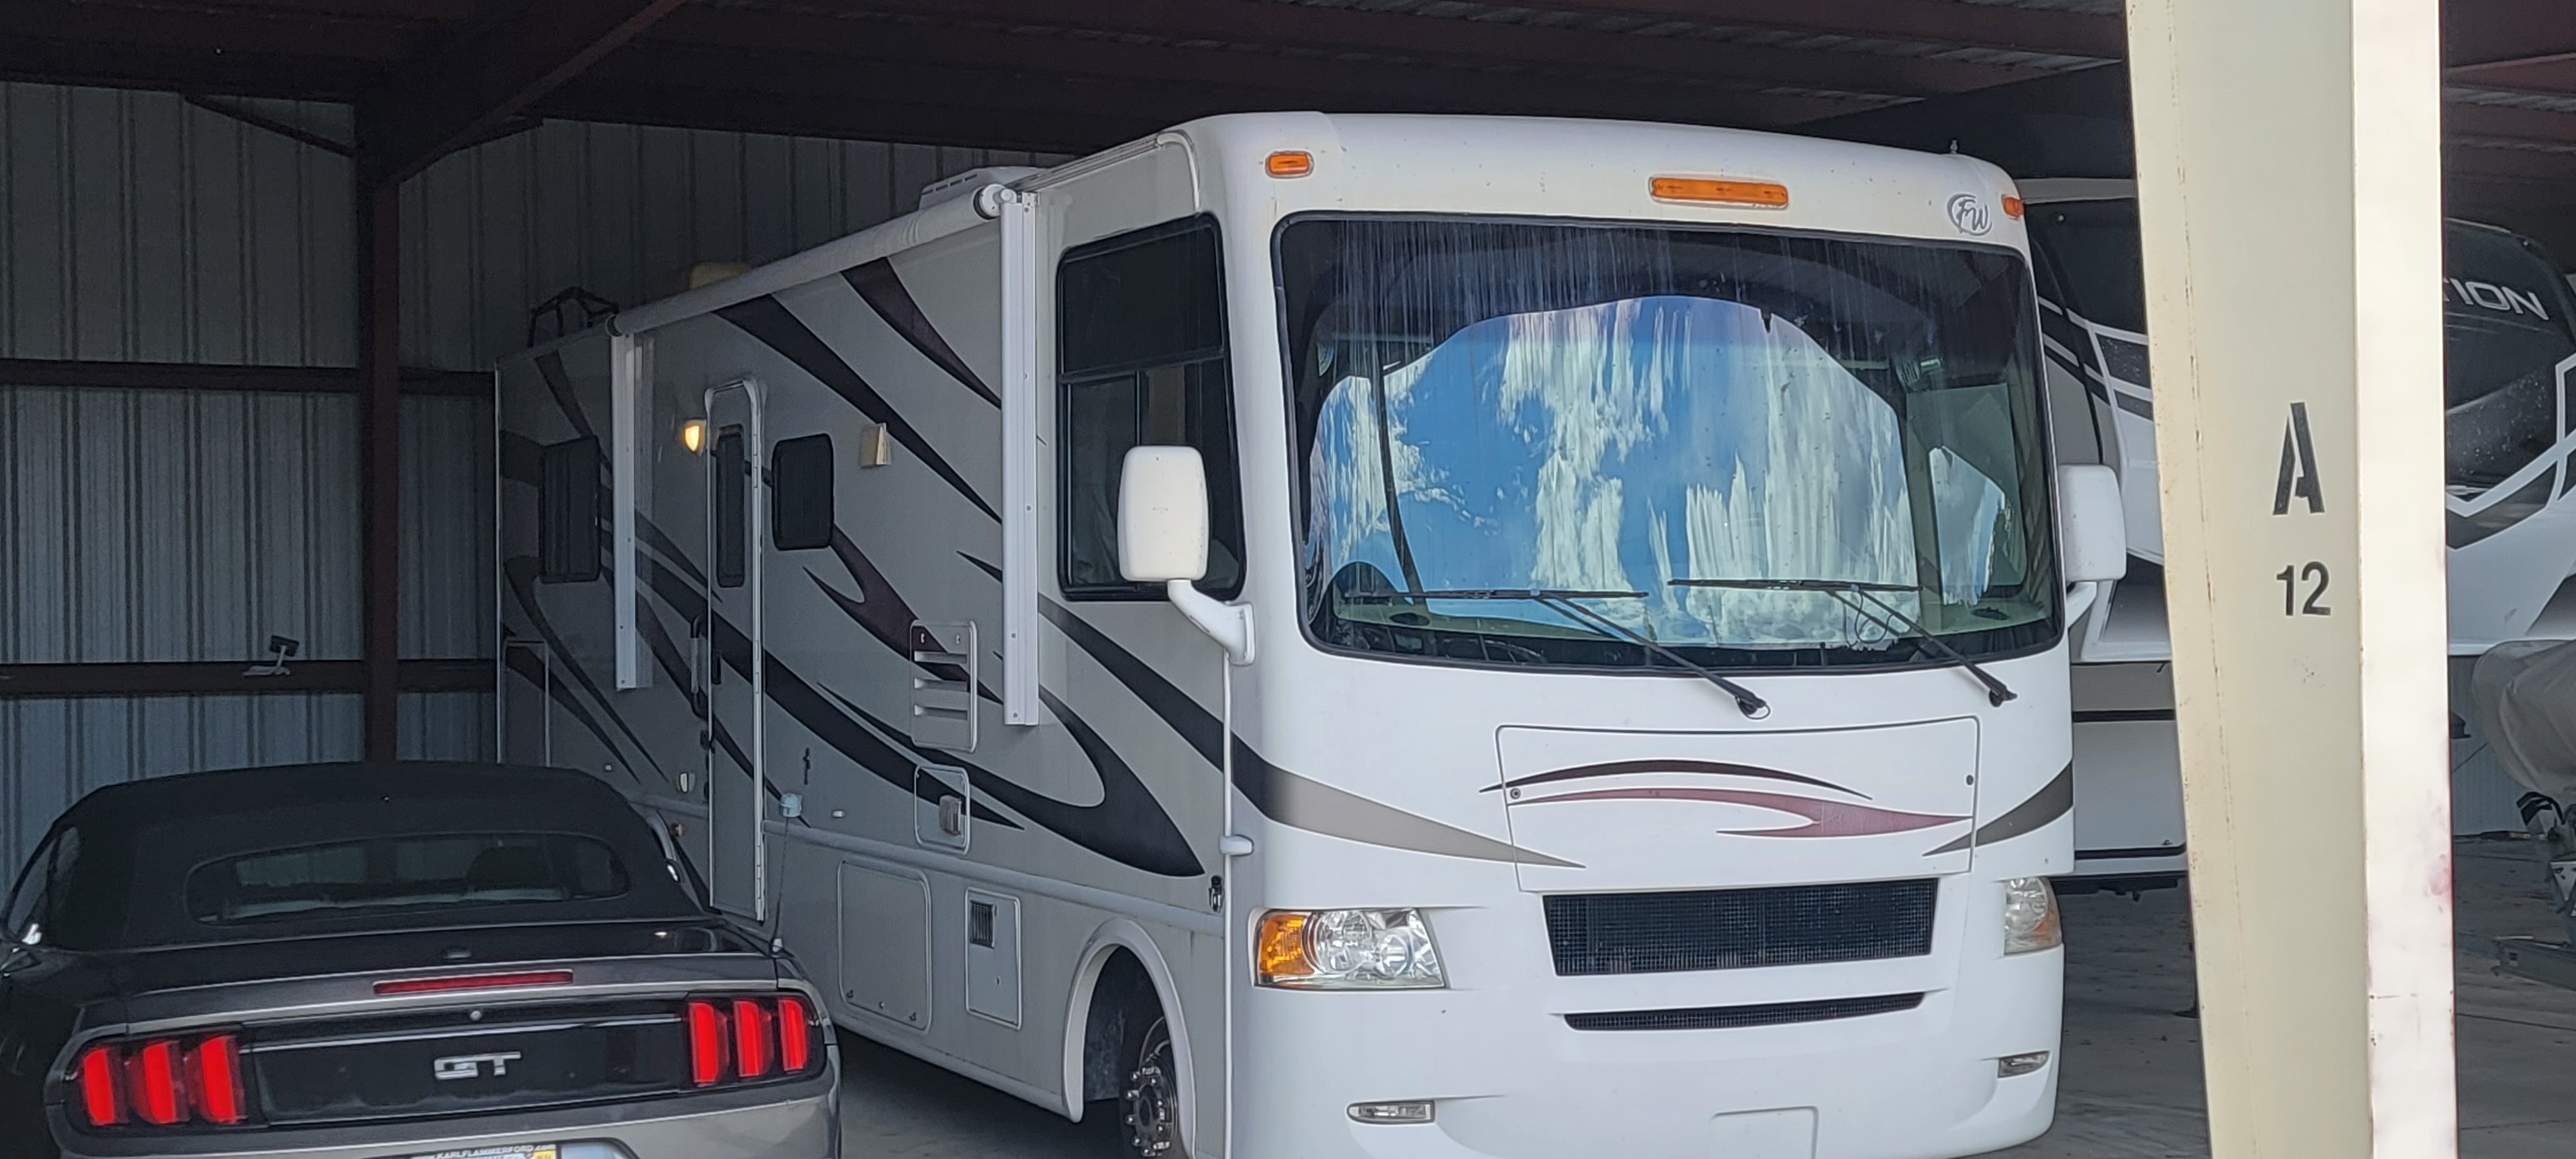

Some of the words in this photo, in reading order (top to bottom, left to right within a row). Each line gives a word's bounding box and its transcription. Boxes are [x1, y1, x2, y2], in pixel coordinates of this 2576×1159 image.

[2443, 277, 2549, 320] ION
[2273, 402, 2325, 515] A
[2276, 561, 2331, 616] 12
[434, 1051, 521, 1080] GT
